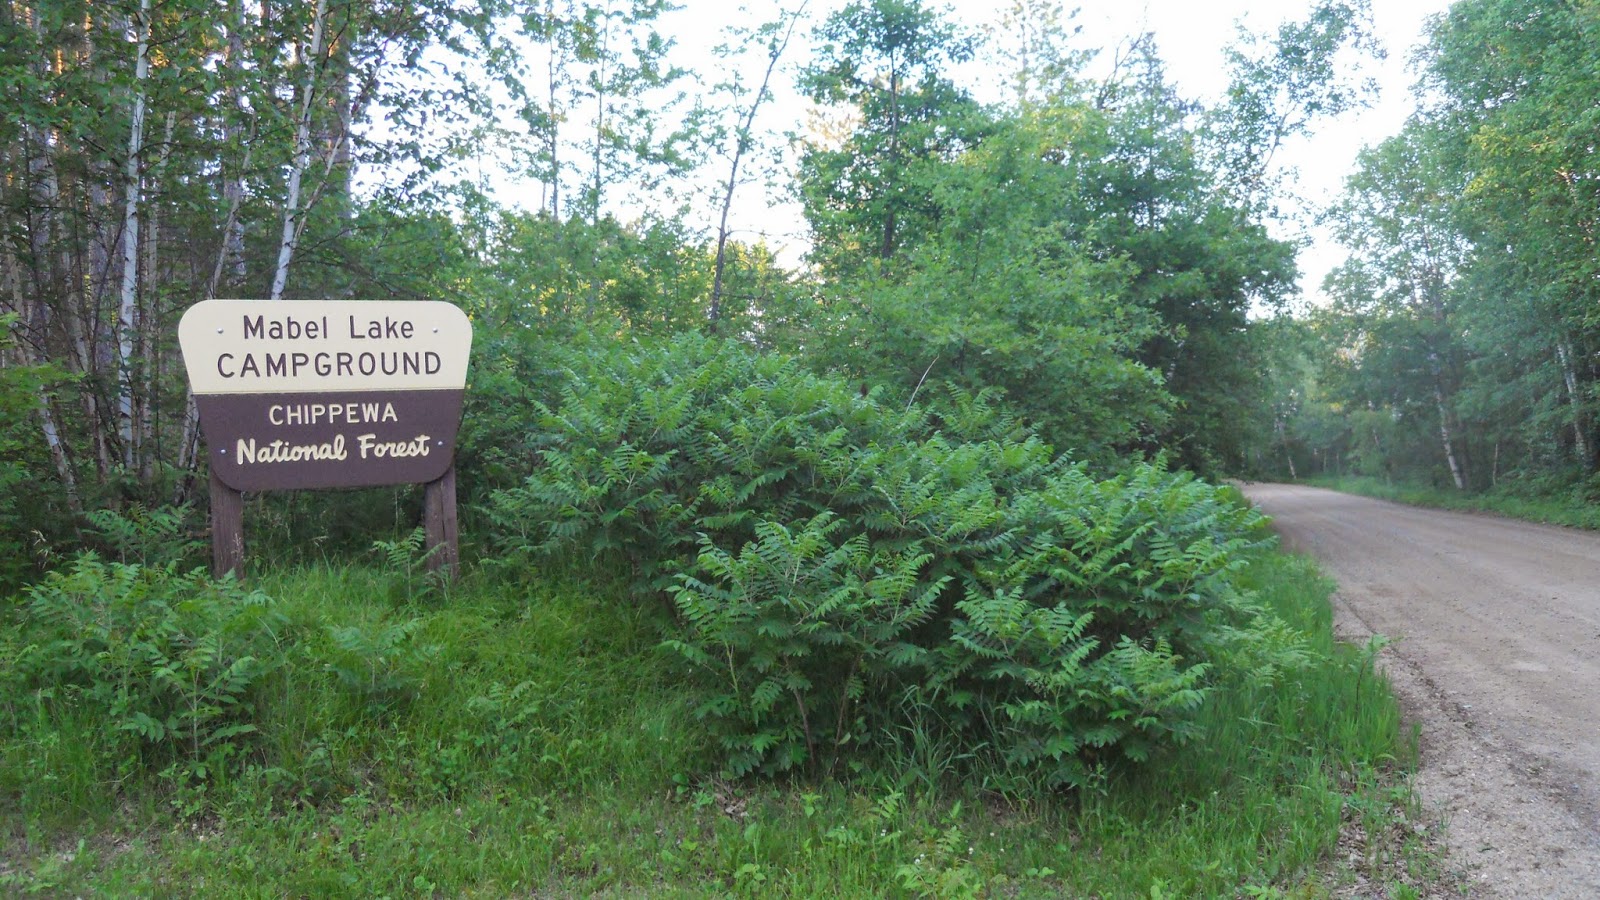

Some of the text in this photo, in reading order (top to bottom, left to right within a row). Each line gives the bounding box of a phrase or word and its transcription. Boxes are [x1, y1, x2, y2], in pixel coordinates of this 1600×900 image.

[243, 315, 414, 340] Mabel Lake
[217, 351, 441, 378] CAMPGROUND
[269, 402, 398, 426] CHIPPEWA
[236, 433, 431, 465] National Forest
